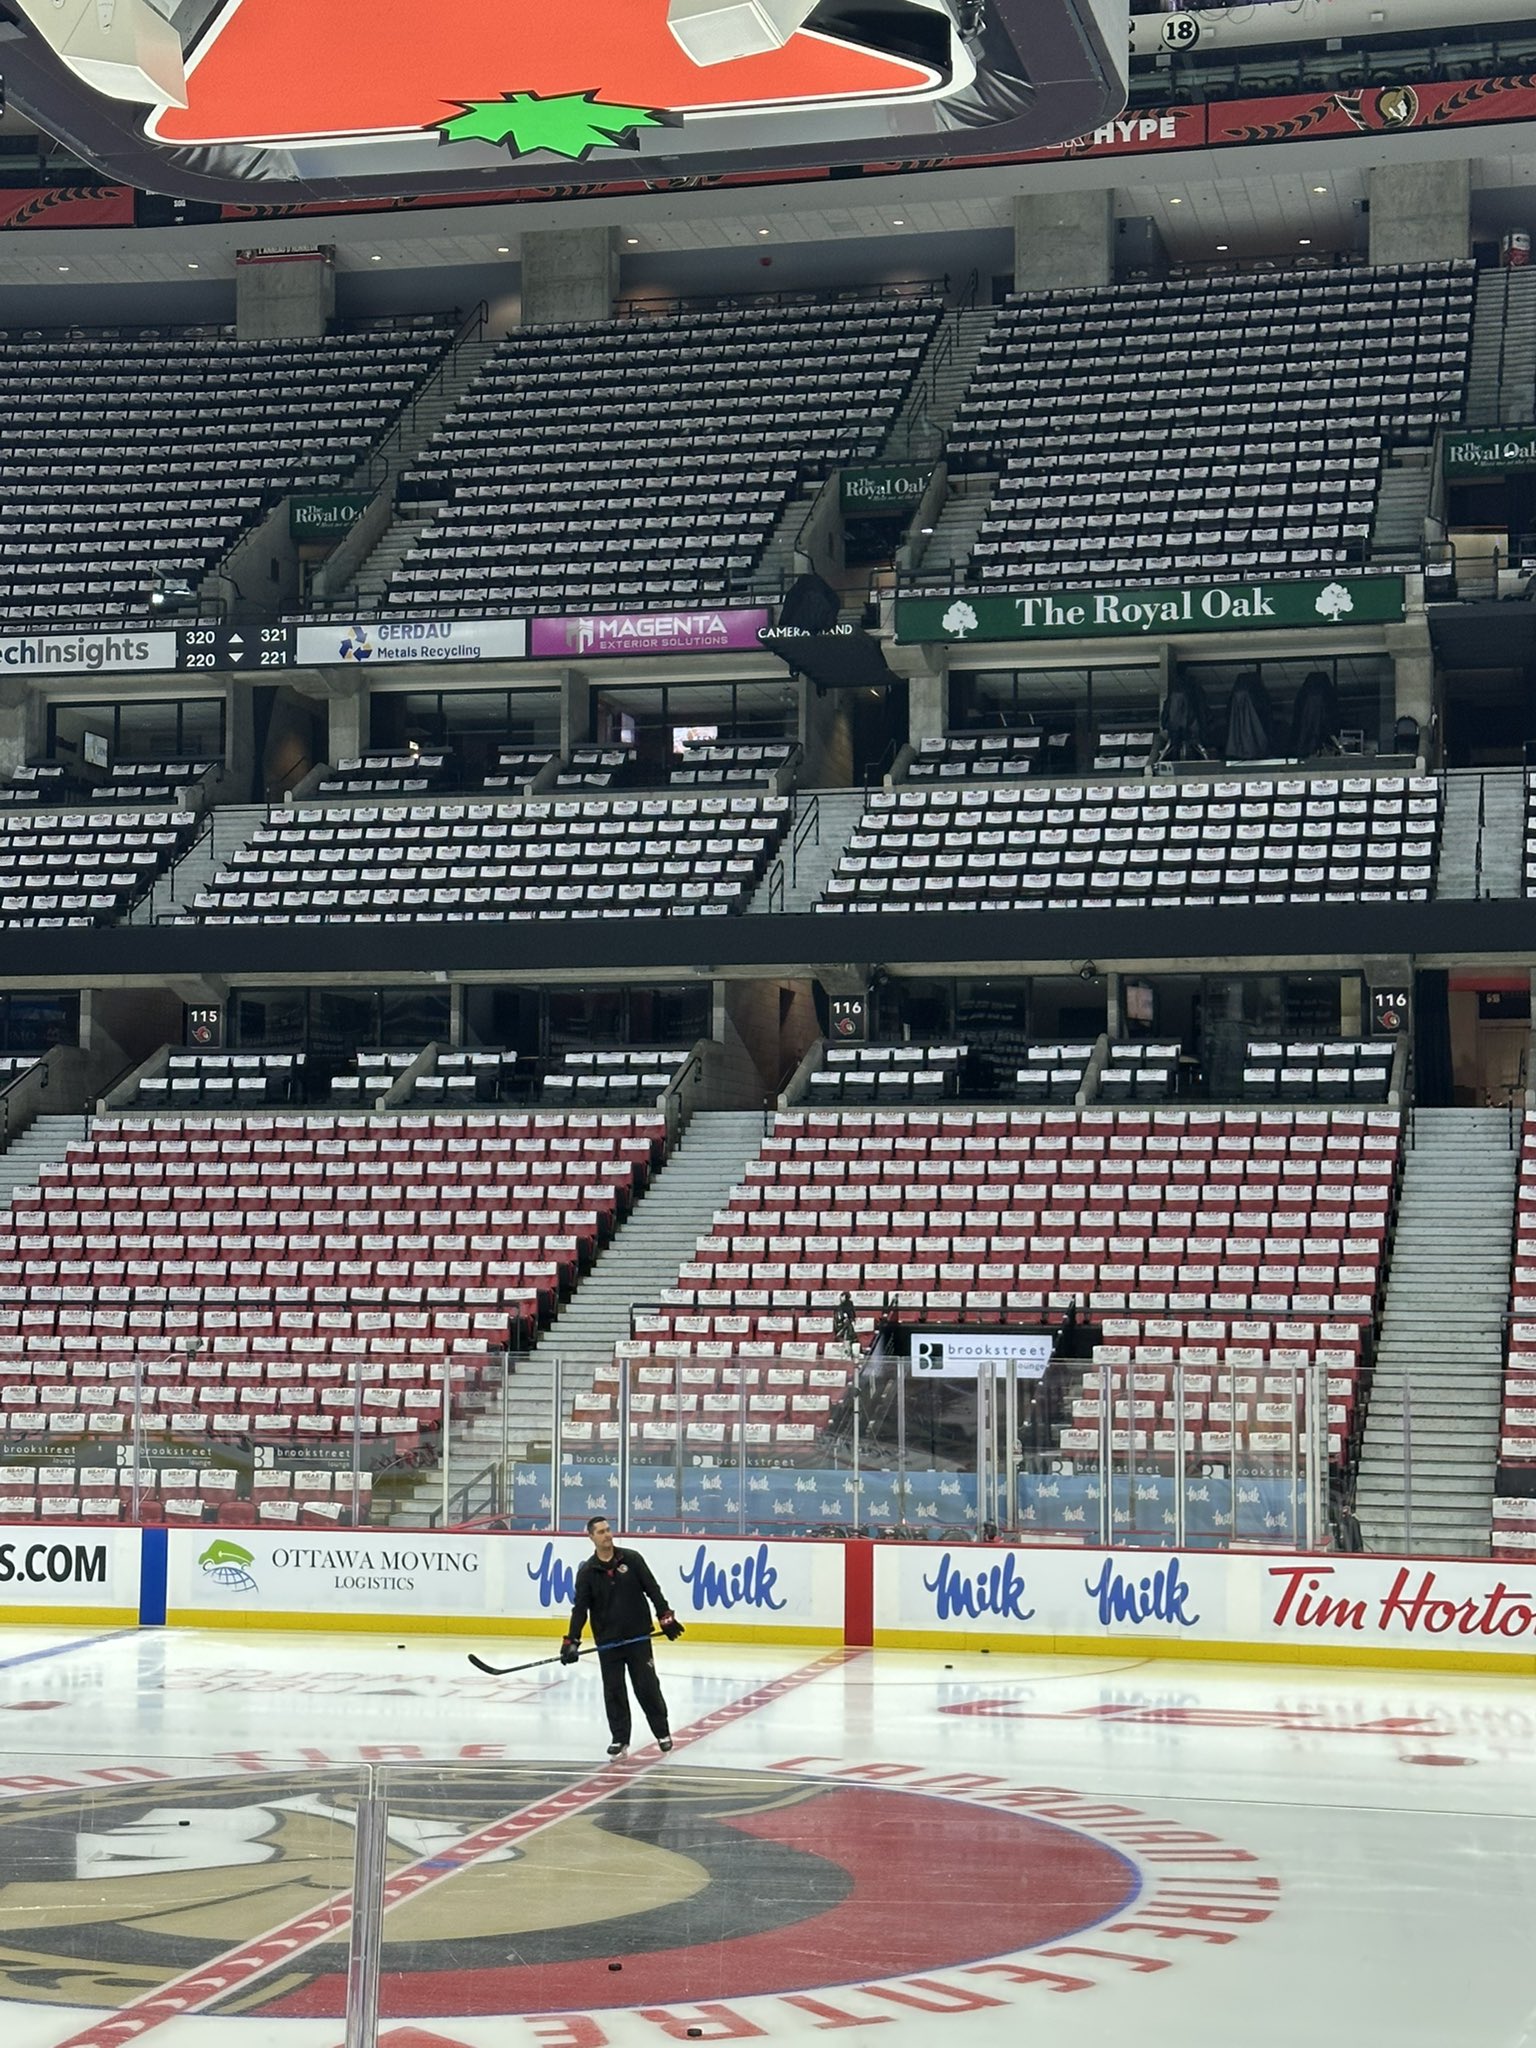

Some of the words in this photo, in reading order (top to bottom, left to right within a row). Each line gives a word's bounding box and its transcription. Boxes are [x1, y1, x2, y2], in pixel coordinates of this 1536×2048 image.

[1167, 21, 1193, 39] 18
[1094, 116, 1176, 144] HYPE
[1450, 444, 1500, 465] Royal
[846, 480, 892, 499] Royal
[295, 506, 338, 526] Royal
[1015, 598, 1086, 626] The
[1093, 591, 1193, 630] Royal
[1201, 587, 1277, 619] Oak
[260, 628, 287, 642] 321
[377, 623, 452, 641] GERDAU
[599, 614, 728, 638] MAGENTA
[185, 631, 216, 645] 320
[599, 639, 659, 650] EXTERIOR
[661, 636, 729, 647] SOLUTIONS
[0, 636, 150, 670] chInsights
[260, 652, 287, 665] 221
[377, 644, 416, 658] Metals
[420, 642, 481, 660] Recycling
[185, 654, 216, 667] 220
[833, 1001, 861, 1014] 116
[1375, 993, 1406, 1006] 116
[191, 1010, 217, 1022] 115
[948, 1344, 1046, 1356] brookstreet
[1018, 1362, 1046, 1371] ounge
[3, 1444, 76, 1454] brookstreet
[277, 1448, 350, 1458] brookstreet
[272, 1547, 375, 1570] OTTAWA
[381, 1549, 479, 1573] MOVING
[334, 1575, 415, 1591] LOGISTICS
[679, 1543, 787, 1611] Milk
[924, 1552, 1035, 1622] Milk
[1085, 1556, 1199, 1627] Milk
[1268, 1565, 1366, 1630] Tim
[1378, 1566, 1536, 1637] Horto
[212, 1743, 507, 1772] TIRE
[765, 1756, 1260, 1862] CANADIAN
[1104, 1875, 1281, 1946] TIRE
